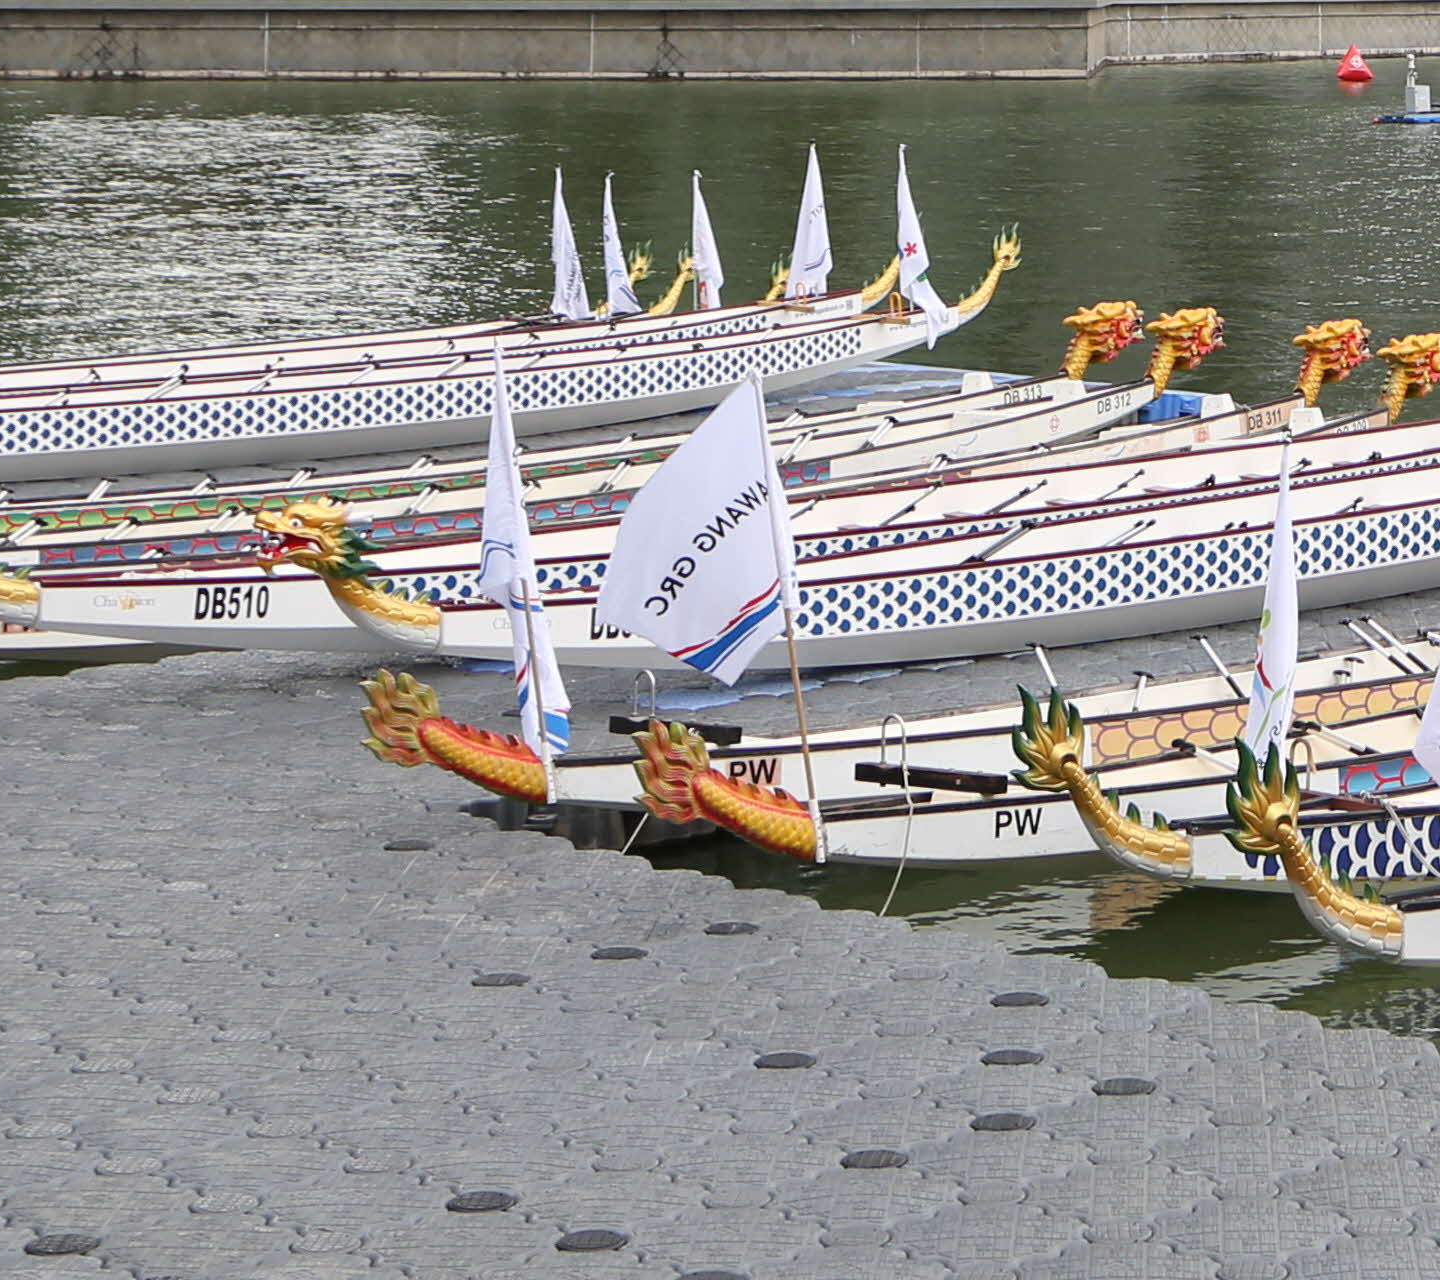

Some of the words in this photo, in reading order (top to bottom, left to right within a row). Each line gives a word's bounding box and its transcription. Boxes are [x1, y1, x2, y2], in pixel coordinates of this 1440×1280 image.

[1097, 399, 1111, 414] DB
[1114, 393, 1131, 409] 312
[1248, 414, 1263, 430] DB
[1266, 410, 1282, 425] 311
[195, 585, 269, 620] DB510
[728, 758, 777, 785] PW
[995, 807, 1043, 839] PW
